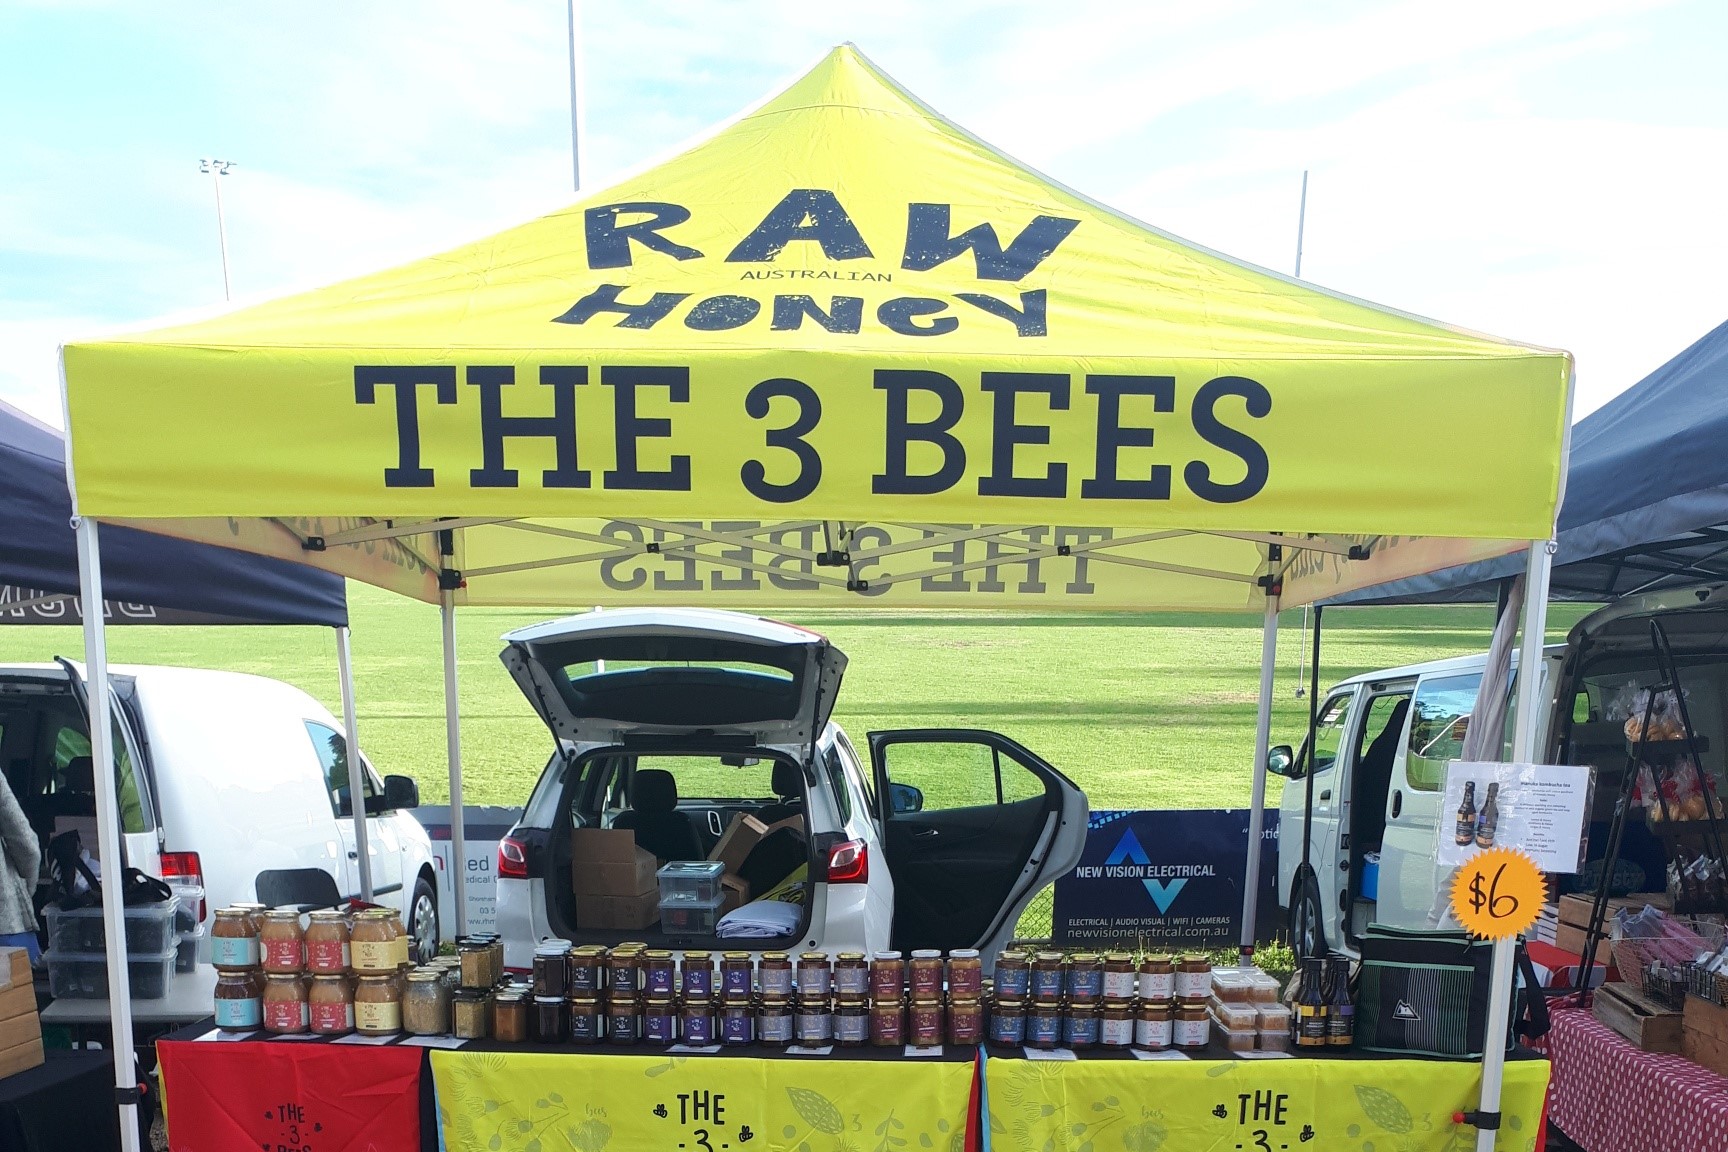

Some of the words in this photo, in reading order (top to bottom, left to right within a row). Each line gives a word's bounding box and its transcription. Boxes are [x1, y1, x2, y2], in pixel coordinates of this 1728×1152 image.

[584, 189, 1081, 282] RAW
[740, 269, 892, 282] AUSTRALIAN
[551, 284, 1047, 337] HONEY
[354, 365, 691, 491] THE
[741, 378, 822, 503] 3
[872, 369, 1271, 503] BEES
[464, 856, 489, 871] ed
[1076, 866, 1102, 878] NEW
[1106, 866, 1144, 878] VISION
[1147, 865, 1216, 877] ELECTRICAL
[465, 875, 491, 884] edical
[1469, 863, 1518, 918] $6
[1067, 926, 1229, 938] newvisionelectrical.com.au
[1069, 918, 1108, 926] ELECTRICAL
[1115, 918, 1139, 926] AUDIO
[1140, 918, 1165, 926] VISUAL
[1172, 917, 1188, 925] WIFI
[1195, 917, 1230, 925] CAMERAS
[277, 1102, 305, 1124] THE
[677, 1090, 725, 1125] THE
[1238, 1090, 1288, 1125] THE
